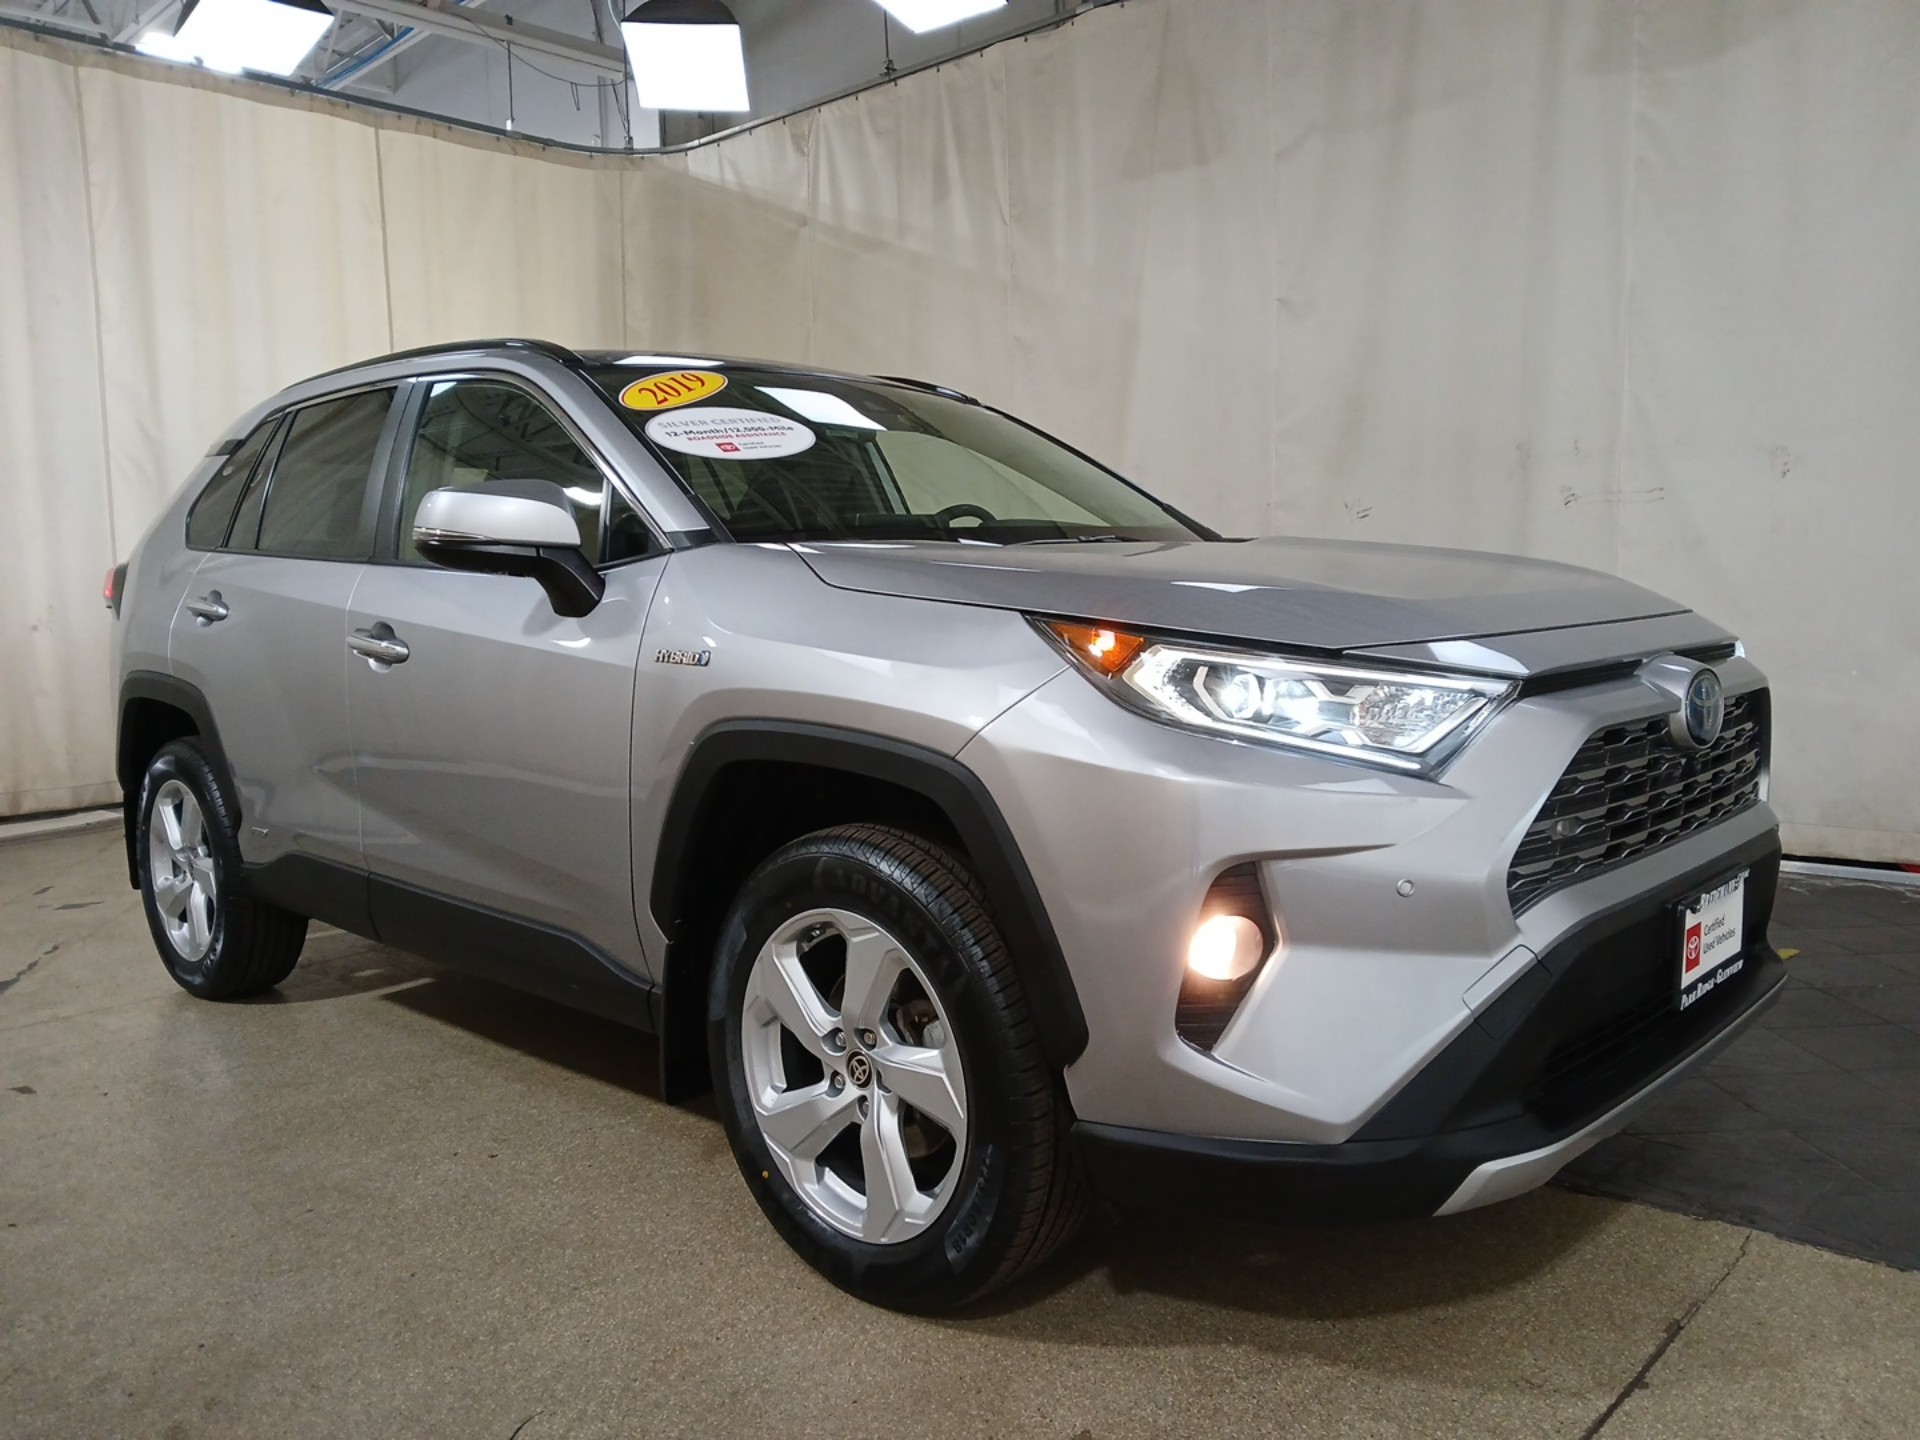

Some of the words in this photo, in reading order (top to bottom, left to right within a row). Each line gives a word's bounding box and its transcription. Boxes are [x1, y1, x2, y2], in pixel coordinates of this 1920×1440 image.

[638, 373, 705, 406] 2019
[657, 419, 709, 429] SILVER
[711, 416, 781, 426] CERTIFIED
[687, 434, 734, 442] ROADSIDE
[735, 431, 787, 440] ASSISTANCE
[655, 649, 699, 665] HYBRID
[1704, 914, 1726, 936] Certified
[1703, 940, 1715, 954] Used
[1715, 927, 1736, 946] Vehicles
